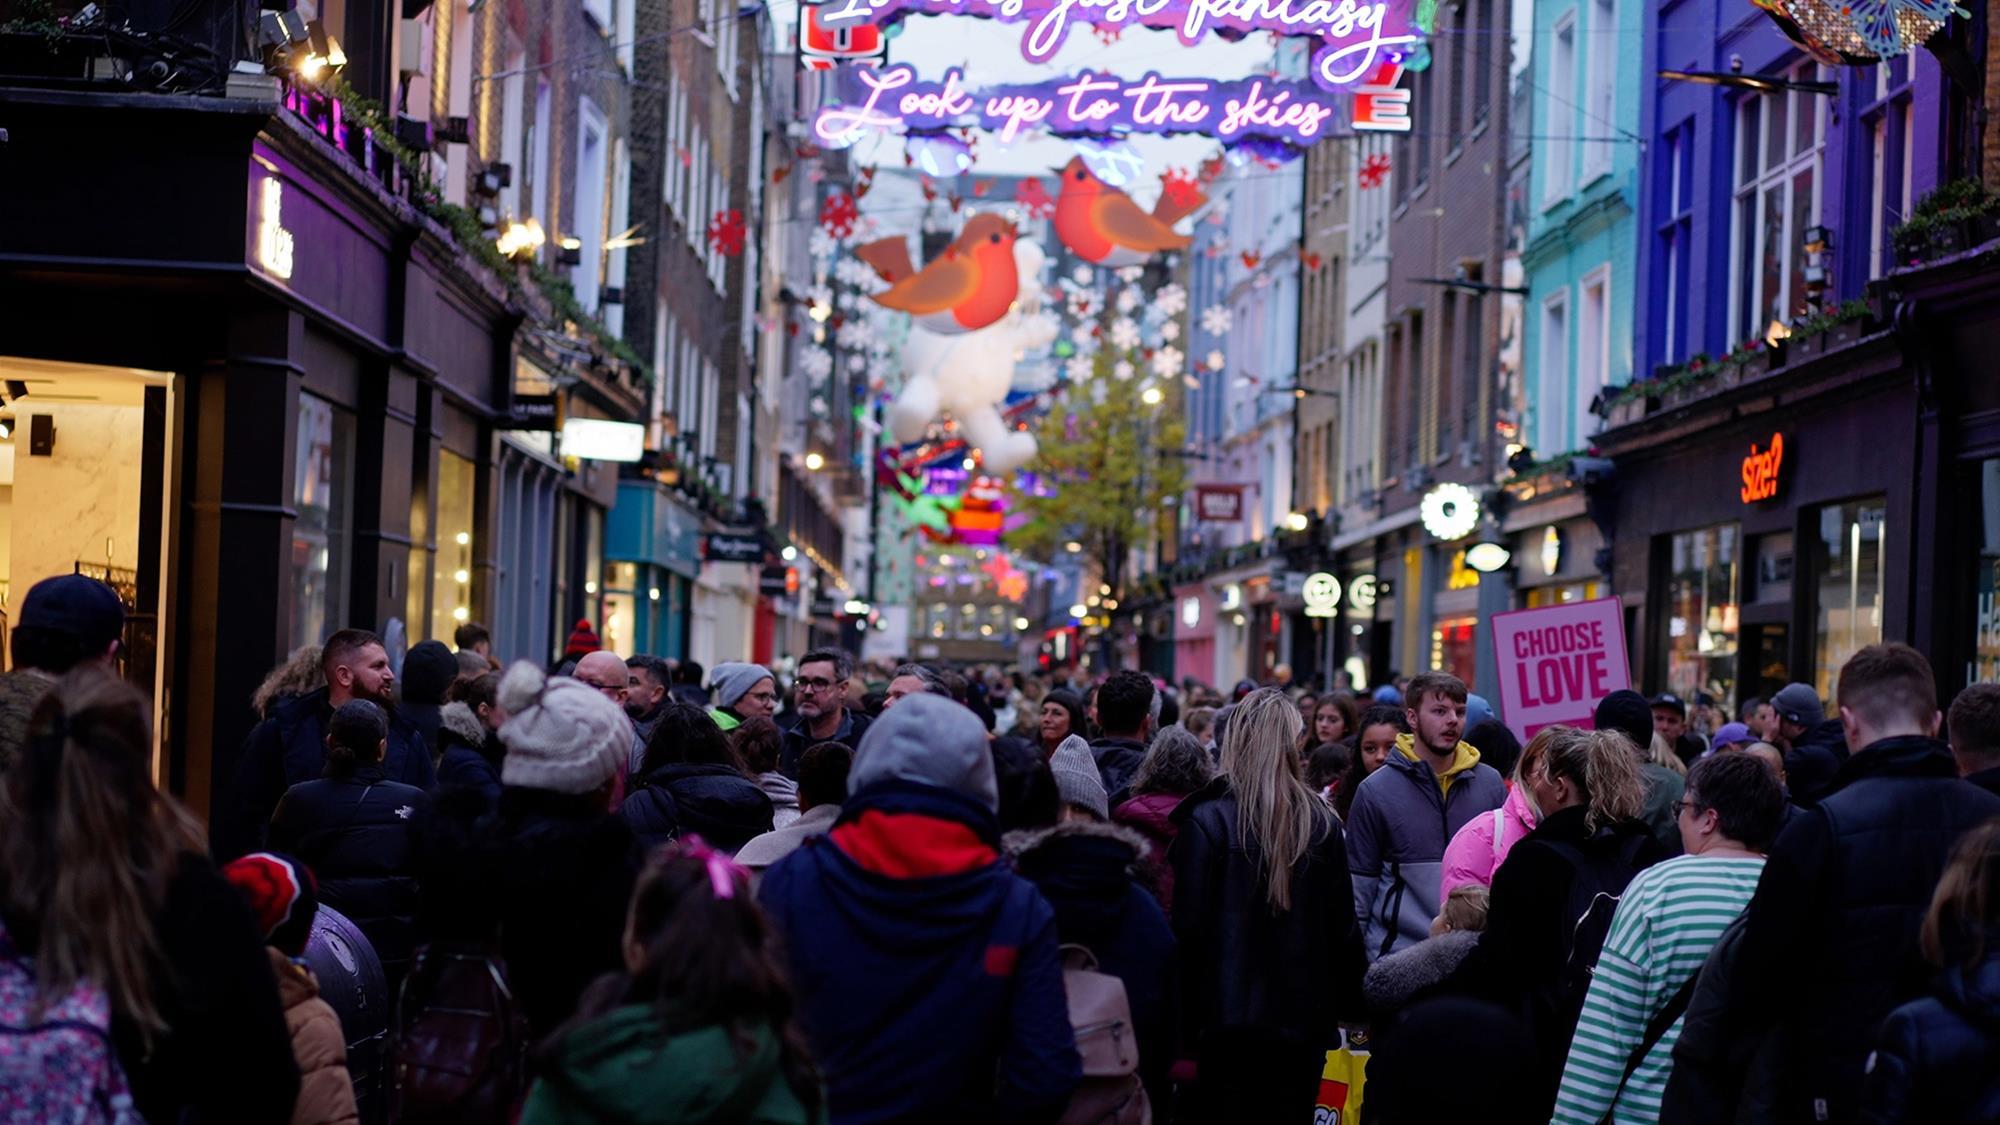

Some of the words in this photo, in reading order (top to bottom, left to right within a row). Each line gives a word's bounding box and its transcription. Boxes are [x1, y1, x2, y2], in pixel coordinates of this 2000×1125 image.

[815, 67, 974, 141] Look
[986, 95, 1054, 144] up
[1056, 73, 1120, 122] to
[1123, 74, 1208, 126] the
[1218, 80, 1331, 136] skies
[1742, 431, 1783, 504] size?
[1513, 621, 1605, 659] CHOOSE
[1516, 651, 1611, 708] LOVE
